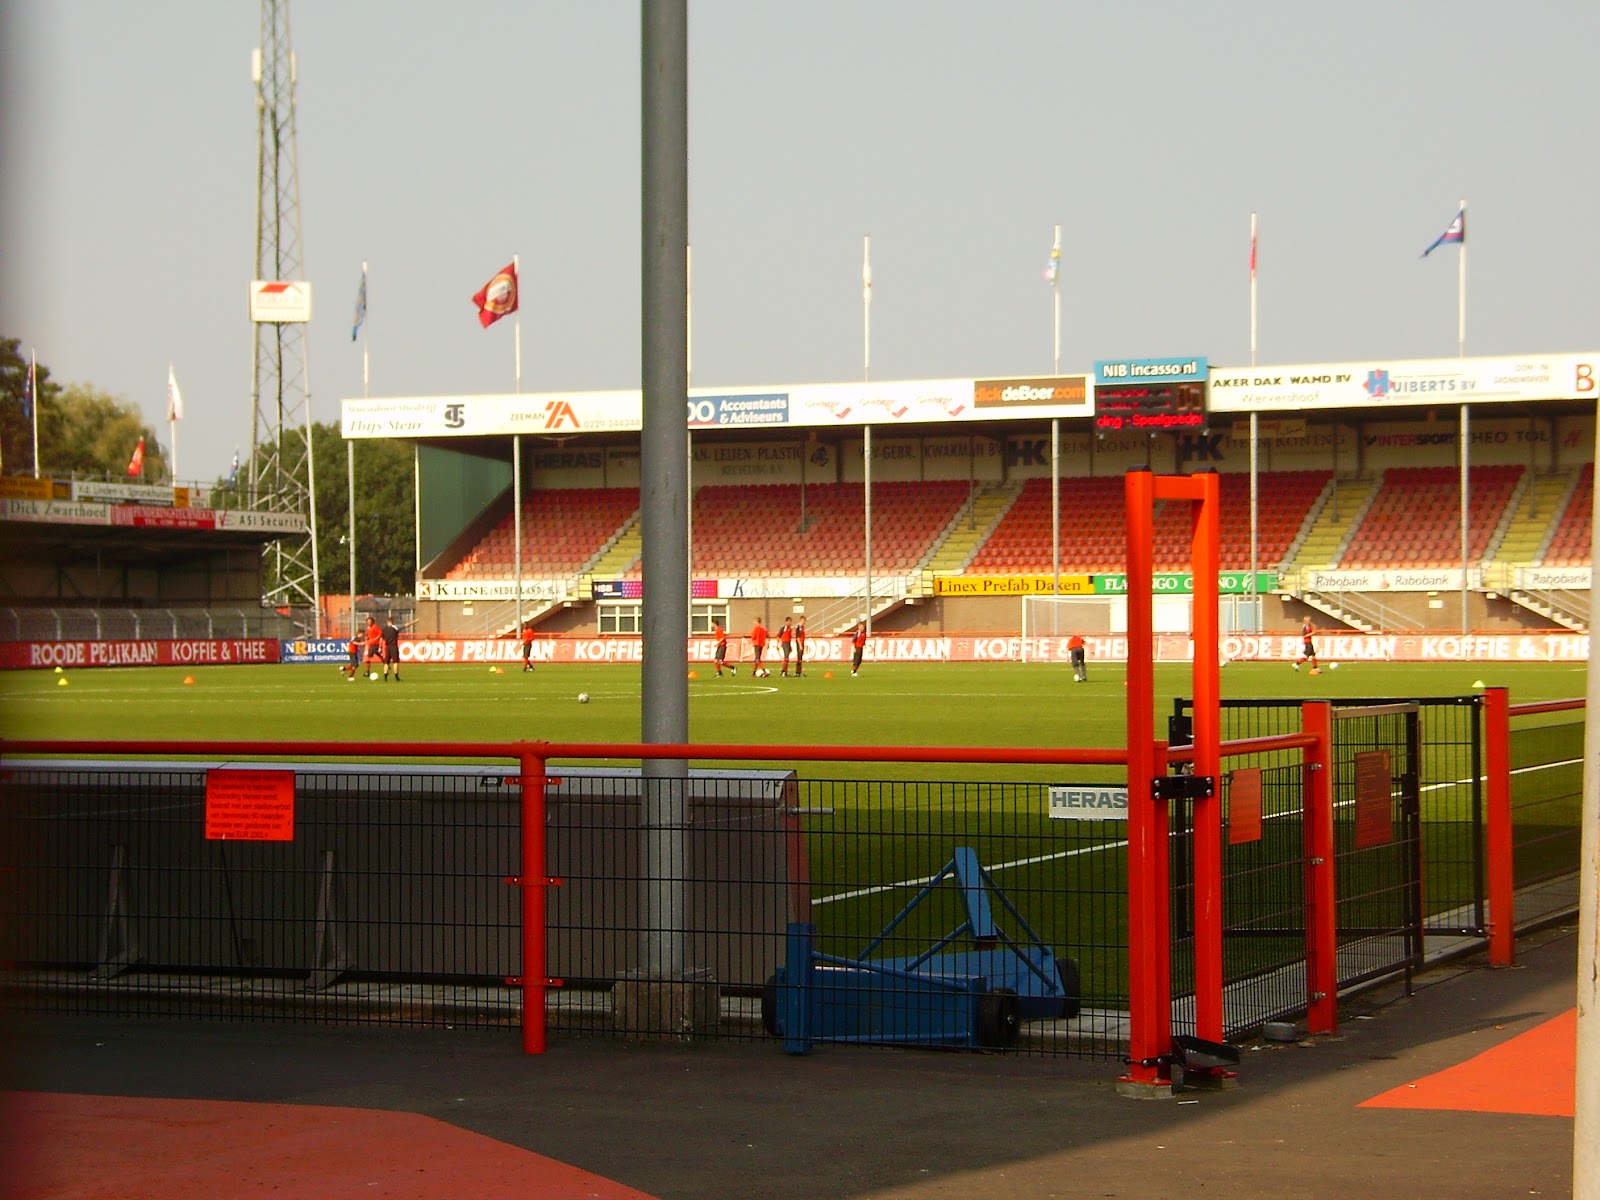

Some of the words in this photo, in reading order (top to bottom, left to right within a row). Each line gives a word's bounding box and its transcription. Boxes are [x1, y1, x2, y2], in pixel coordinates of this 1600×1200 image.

[1104, 363, 1127, 377] NIB
[1254, 377, 1281, 386] DAK
[1336, 374, 1352, 383] BV
[720, 398, 787, 411] Accountants
[511, 413, 545, 422] ZEEMAN
[720, 412, 730, 424] &
[730, 410, 784, 423] Adviseurs
[1471, 431, 1507, 444] HEO
[1008, 439, 1048, 466] HK
[1182, 434, 1223, 462] HK
[240, 515, 257, 527] ASI
[261, 517, 305, 530] Security
[939, 580, 977, 593] Linex
[983, 579, 1030, 592] Prefab
[1317, 576, 1369, 587] Rabobank
[1395, 575, 1449, 586] Rabobank
[1532, 573, 1588, 584] Rabobank
[31, 643, 86, 666] ROODE
[90, 641, 158, 665] PELIKAAN
[172, 641, 218, 662] KOFFIE
[221, 640, 231, 660] &
[235, 640, 266, 660] THEE
[285, 640, 349, 655] NRBCC.N
[398, 641, 456, 661] OODE
[851, 638, 950, 660] ELIKAAN
[974, 638, 1050, 659] KOFFIE
[1422, 637, 1509, 659] KOFFIE
[1516, 637, 1535, 659] &
[1543, 637, 1590, 659] THE
[314, 653, 351, 661] communica
[1052, 791, 1128, 809] HERAS
